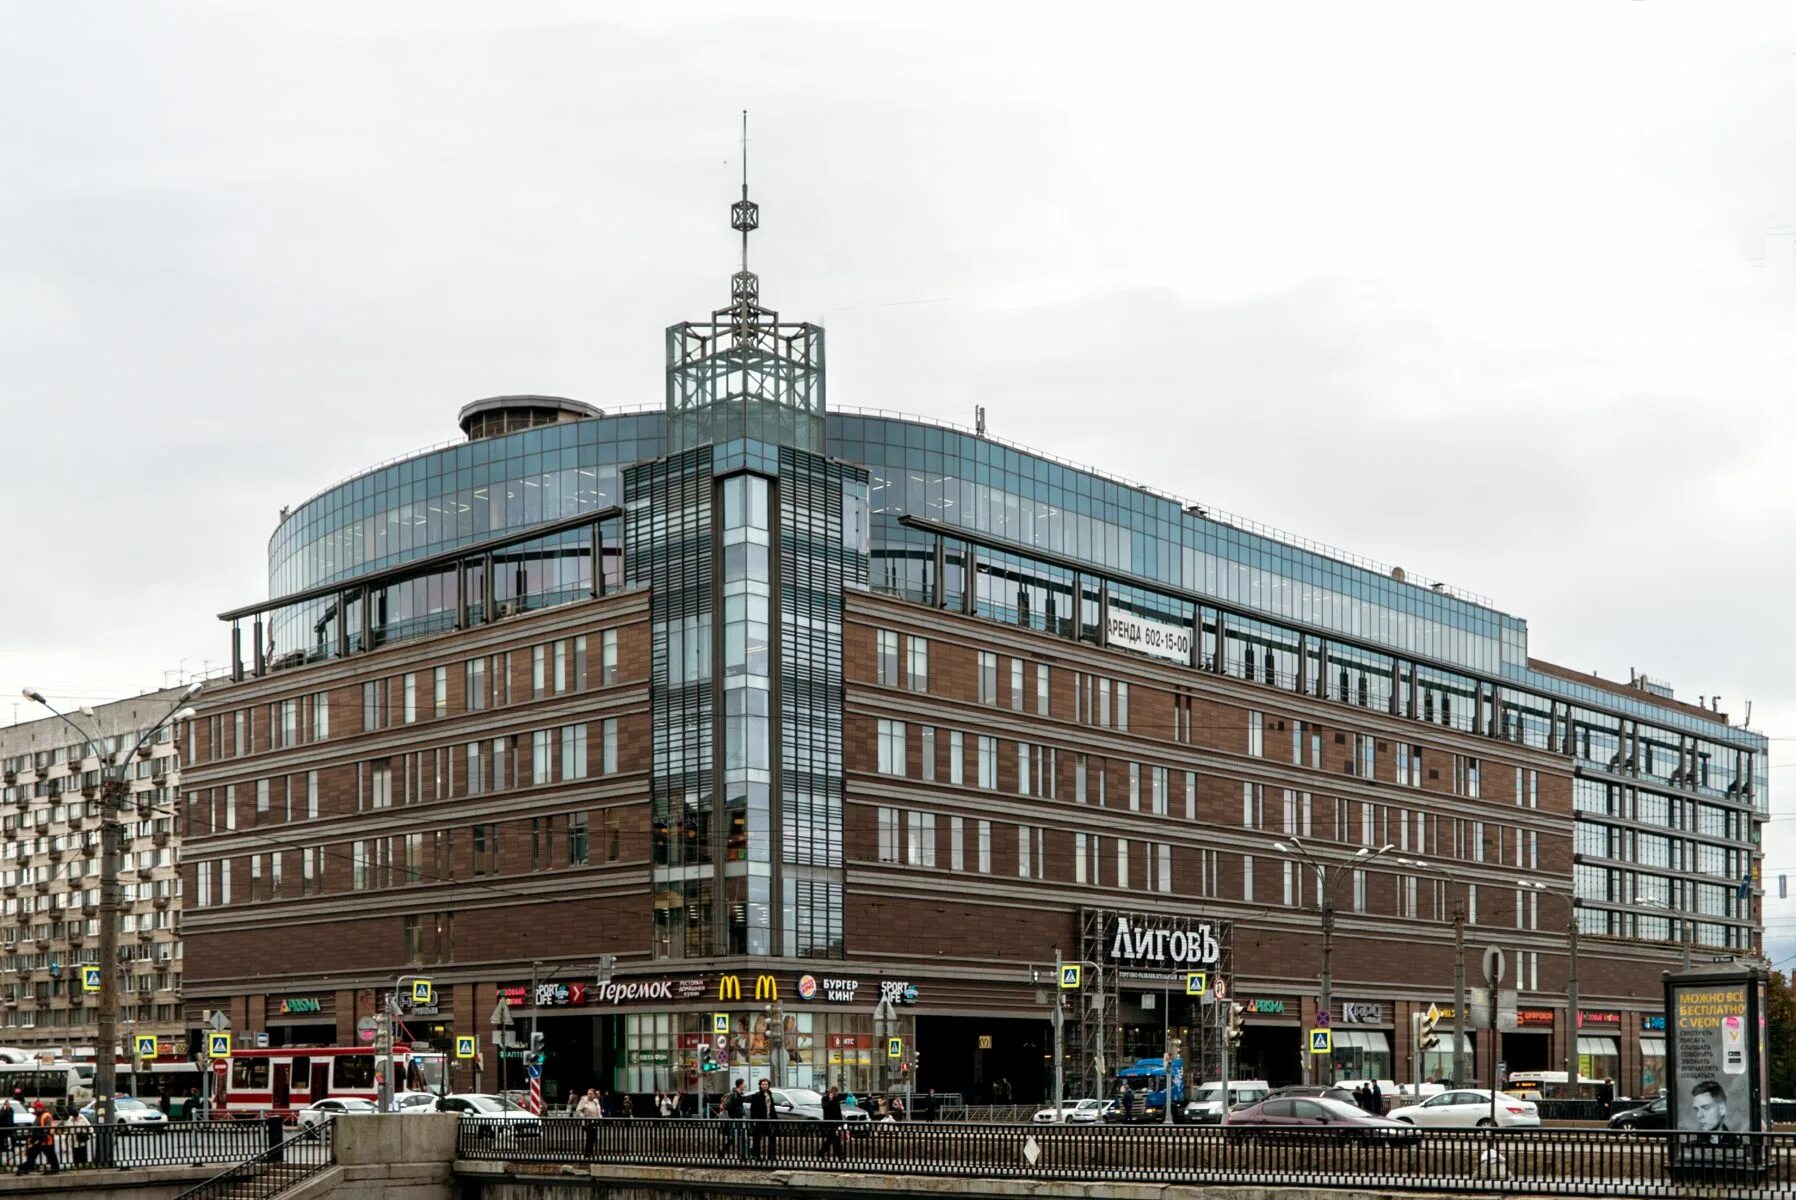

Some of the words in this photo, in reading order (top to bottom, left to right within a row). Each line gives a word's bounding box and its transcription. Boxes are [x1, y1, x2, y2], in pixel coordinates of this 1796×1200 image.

[1108, 618, 1141, 644] АРЕНДА
[1145, 628, 1187, 653] 602-15-00
[823, 979, 858, 990] БУРГЕР
[881, 981, 908, 993] SPORT
[597, 980, 672, 1004] Теремок
[828, 990, 854, 1001] КИНГ
[1680, 993, 1724, 1004] МОЖНО
[1726, 990, 1745, 1002] ВСЁ
[288, 998, 320, 1012] PRISMA
[536, 995, 552, 1005] LIFE
[1256, 1000, 1284, 1013] PRISMA
[1680, 1004, 1745, 1015] БЕСПЛАТНО
[1680, 1018, 1687, 1027] С
[1690, 1017, 1720, 1027] VEON
